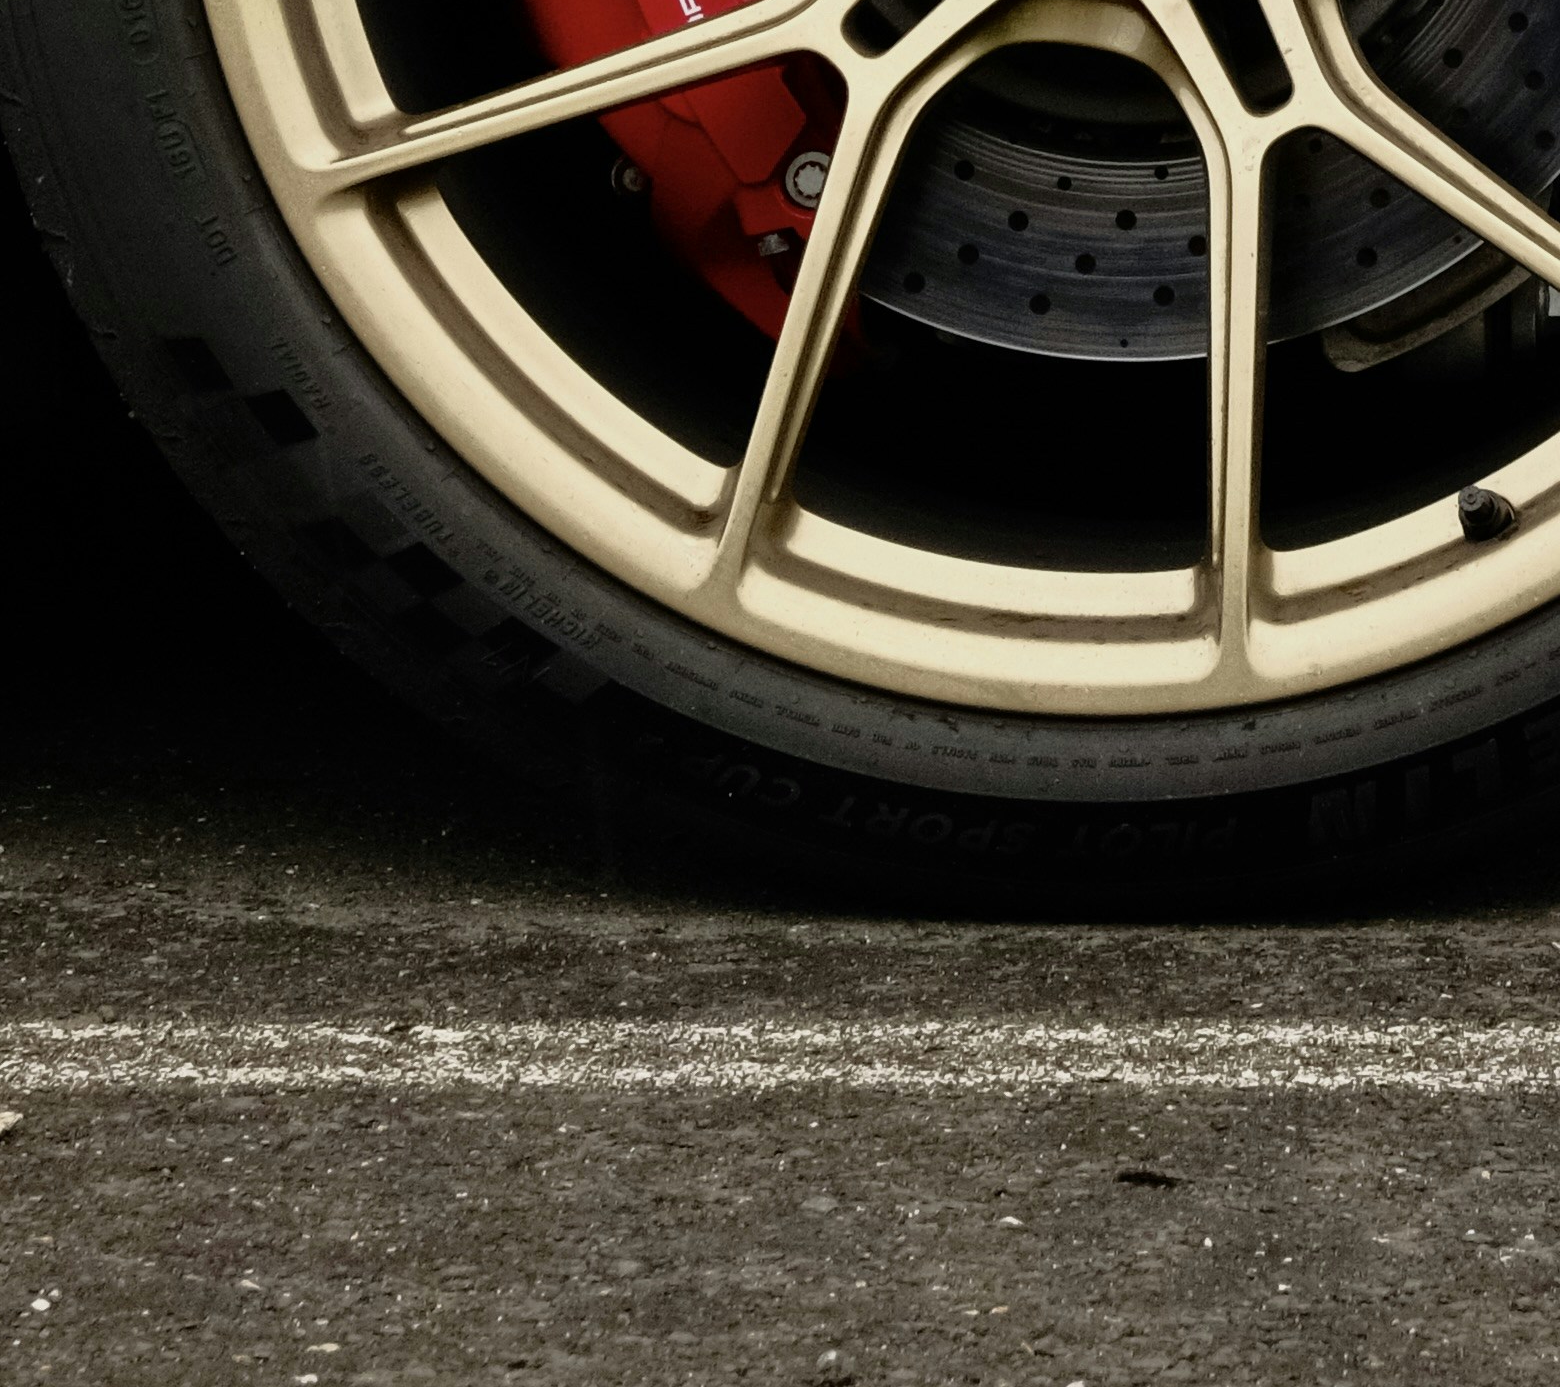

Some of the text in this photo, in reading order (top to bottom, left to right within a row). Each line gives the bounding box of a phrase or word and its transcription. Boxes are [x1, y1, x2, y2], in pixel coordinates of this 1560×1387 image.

[674, 736, 805, 815] CUP
[815, 784, 1037, 859] SPORT
[1055, 813, 1243, 860] PILOT
